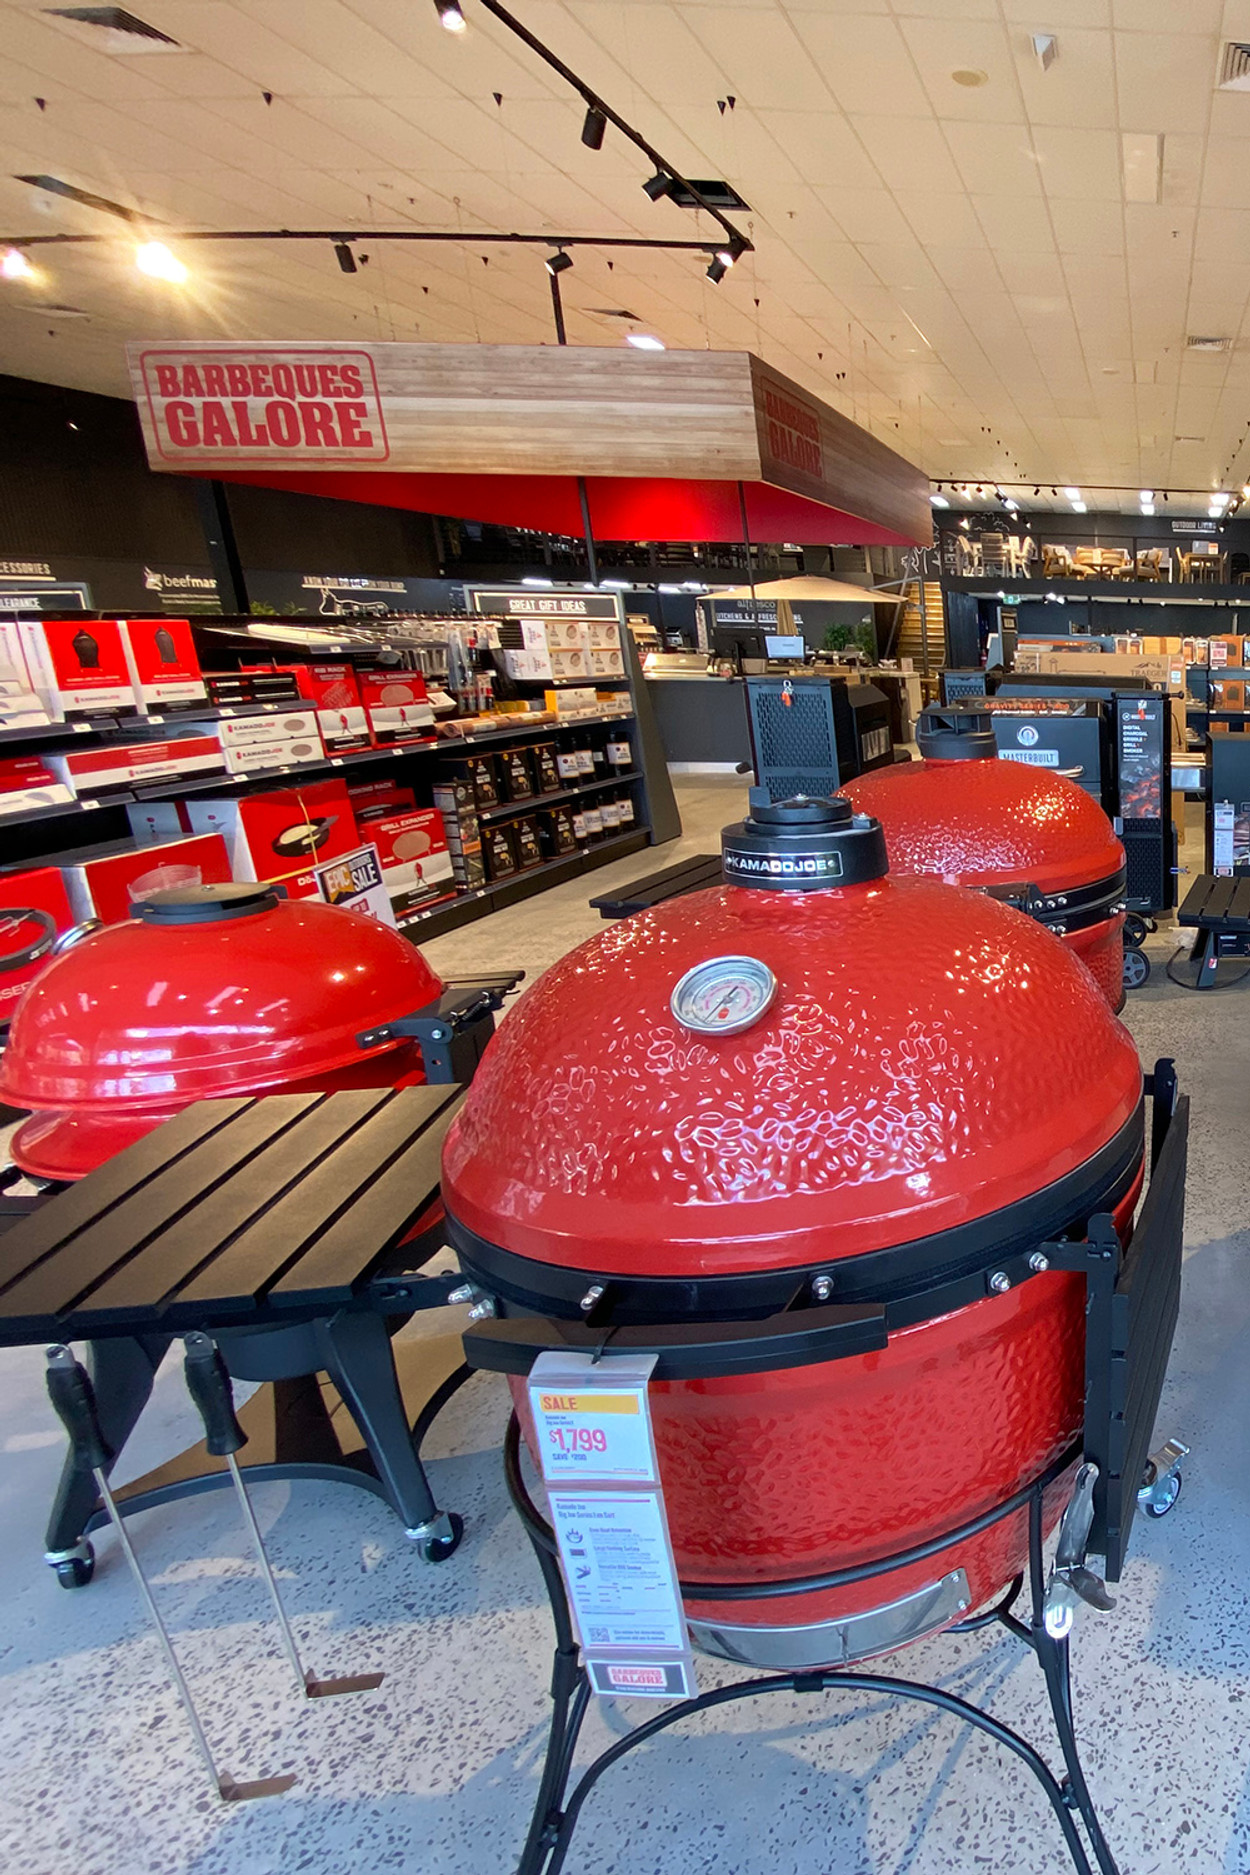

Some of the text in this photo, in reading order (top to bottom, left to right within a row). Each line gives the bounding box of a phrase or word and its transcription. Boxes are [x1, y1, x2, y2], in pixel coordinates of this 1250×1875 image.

[155, 364, 364, 402] BARBEQUES
[165, 401, 374, 447] GALORE
[163, 573, 218, 589] beefmas
[0, 597, 41, 609] LEARANCE
[508, 599, 587, 612] GREAT GIFT IDEAS
[1131, 669, 1167, 677] TRAEGER
[1003, 753, 1054, 763] MASTERBUILT
[731, 856, 828, 873] KAMADOJOE
[326, 865, 351, 894] EPIC
[352, 863, 378, 892] SALE
[543, 1396, 578, 1411] SALE
[549, 1428, 608, 1454] $1,799
[552, 1453, 569, 1461] SAVE
[558, 1511, 567, 1519] Big
[611, 1668, 662, 1676] BARBEQUES
[612, 1674, 664, 1685] GALORE
